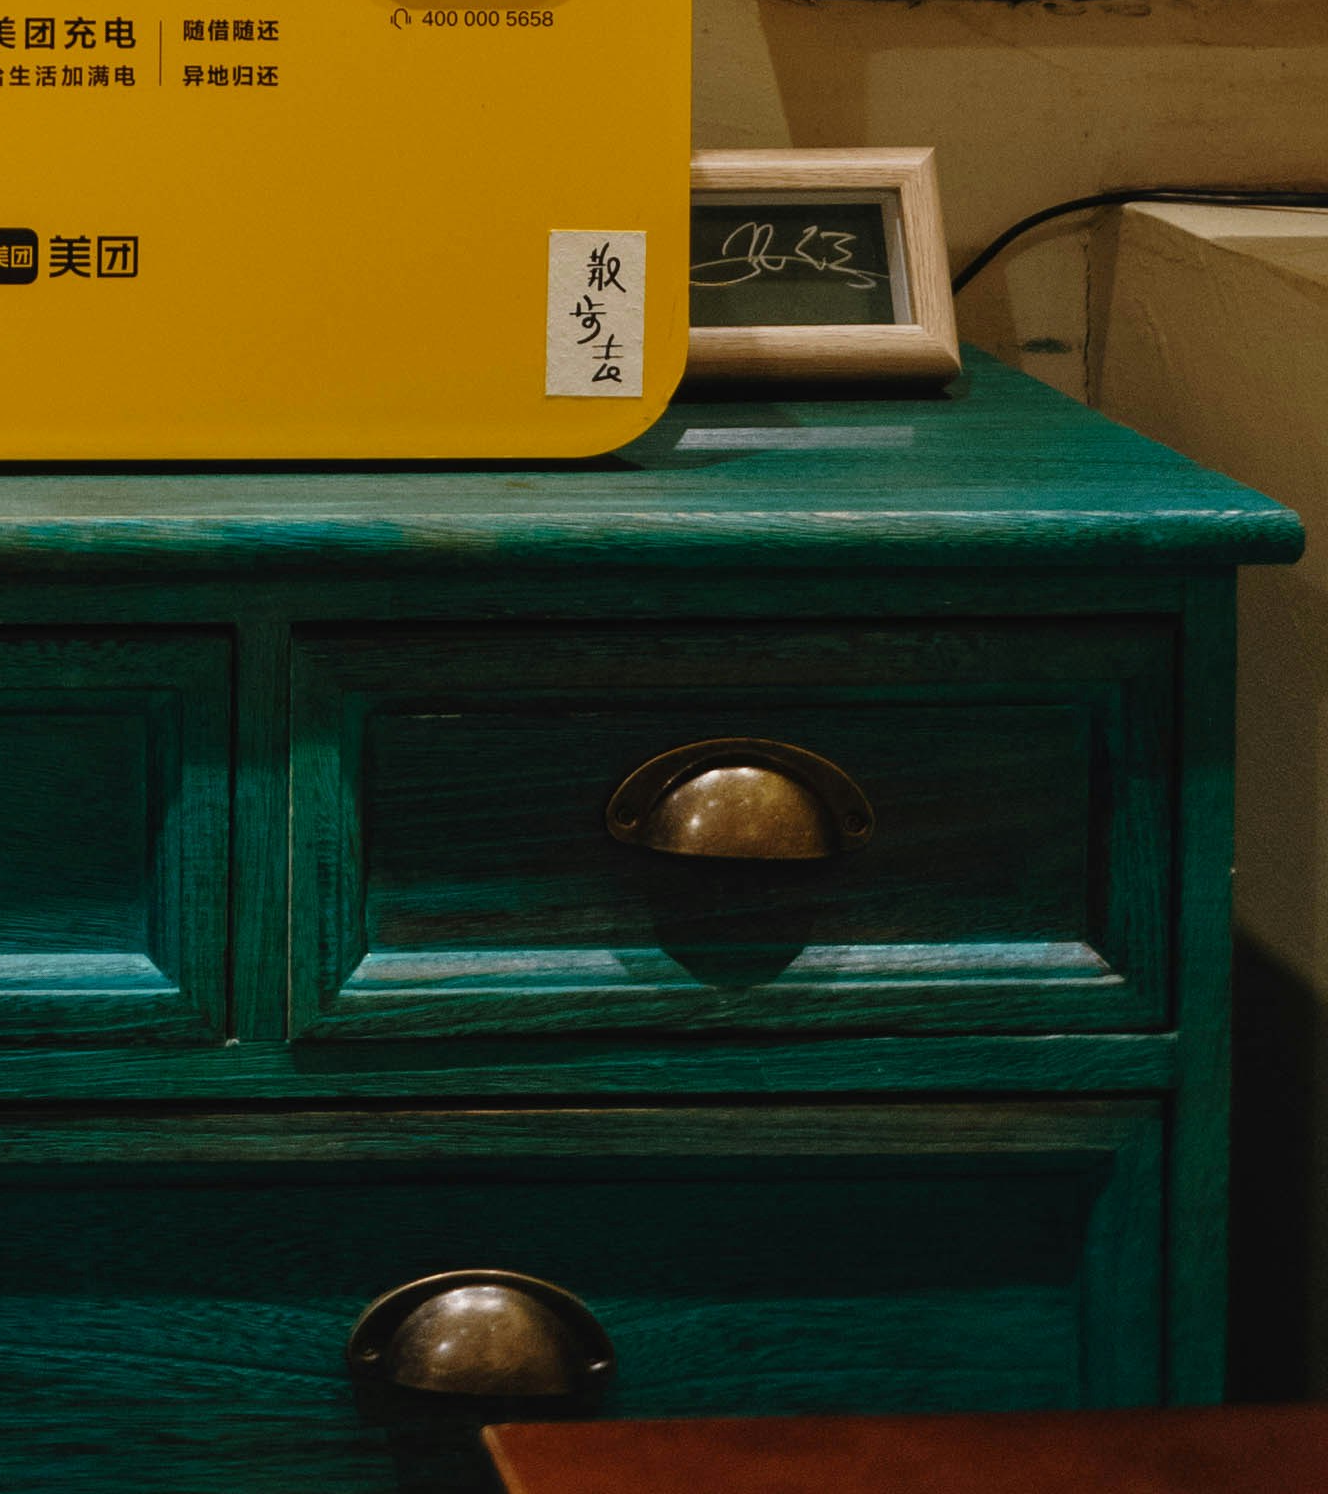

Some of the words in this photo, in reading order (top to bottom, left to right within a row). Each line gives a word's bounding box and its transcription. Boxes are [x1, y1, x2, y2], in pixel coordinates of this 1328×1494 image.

[422, 10, 458, 27] 400
[464, 10, 500, 27] 000
[506, 10, 554, 27] 5658
[182, 19, 280, 42] 随借随还
[182, 64, 280, 87] 异地归还
[49, 234, 139, 278] 美团
